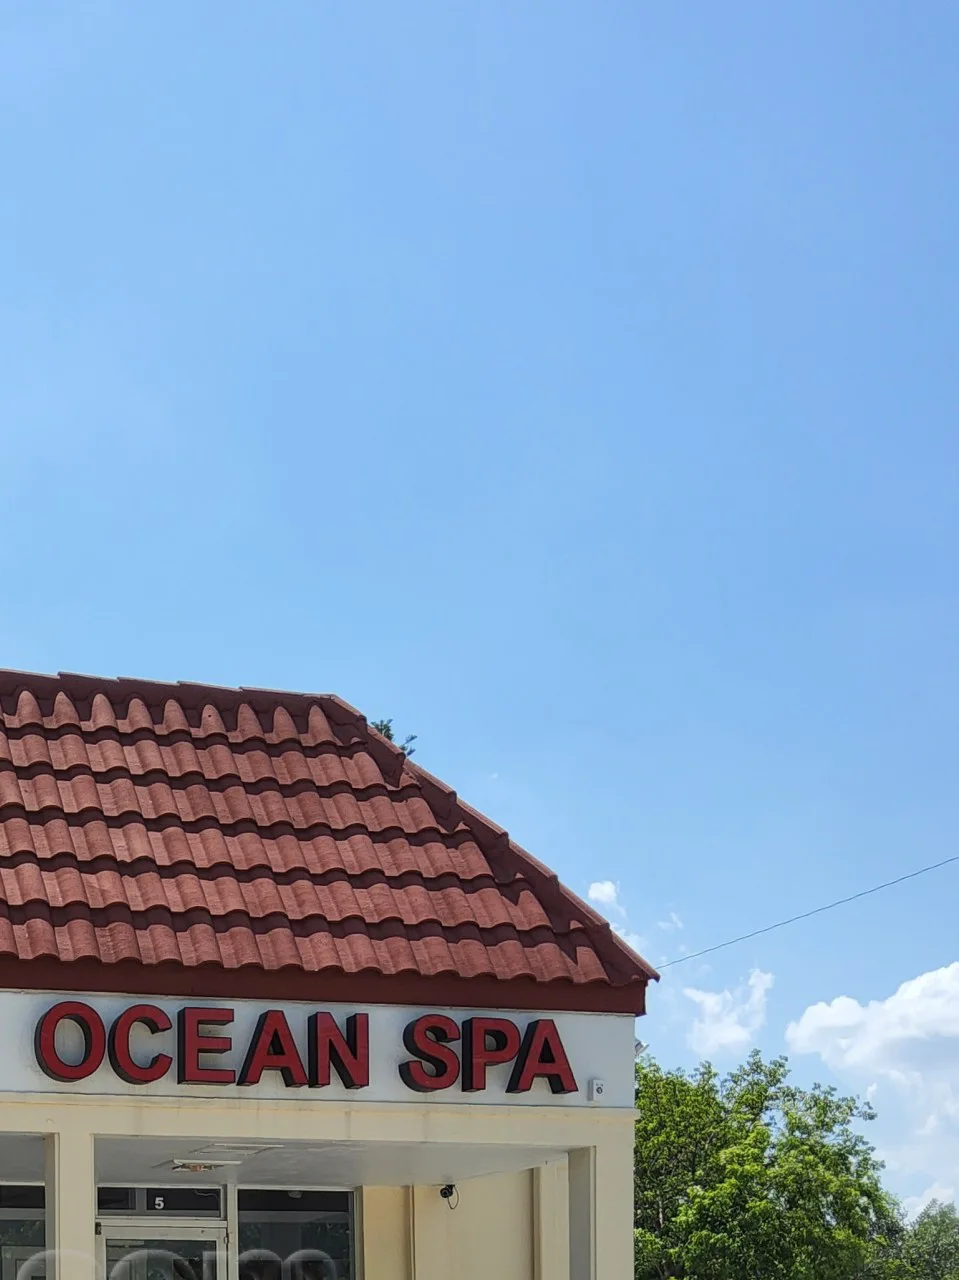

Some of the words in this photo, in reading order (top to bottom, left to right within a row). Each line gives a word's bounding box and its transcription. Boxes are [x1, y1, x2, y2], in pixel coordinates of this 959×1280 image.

[35, 1000, 370, 1090] OCEAN
[398, 1012, 579, 1094] SPA
[154, 1196, 165, 1210] 5
